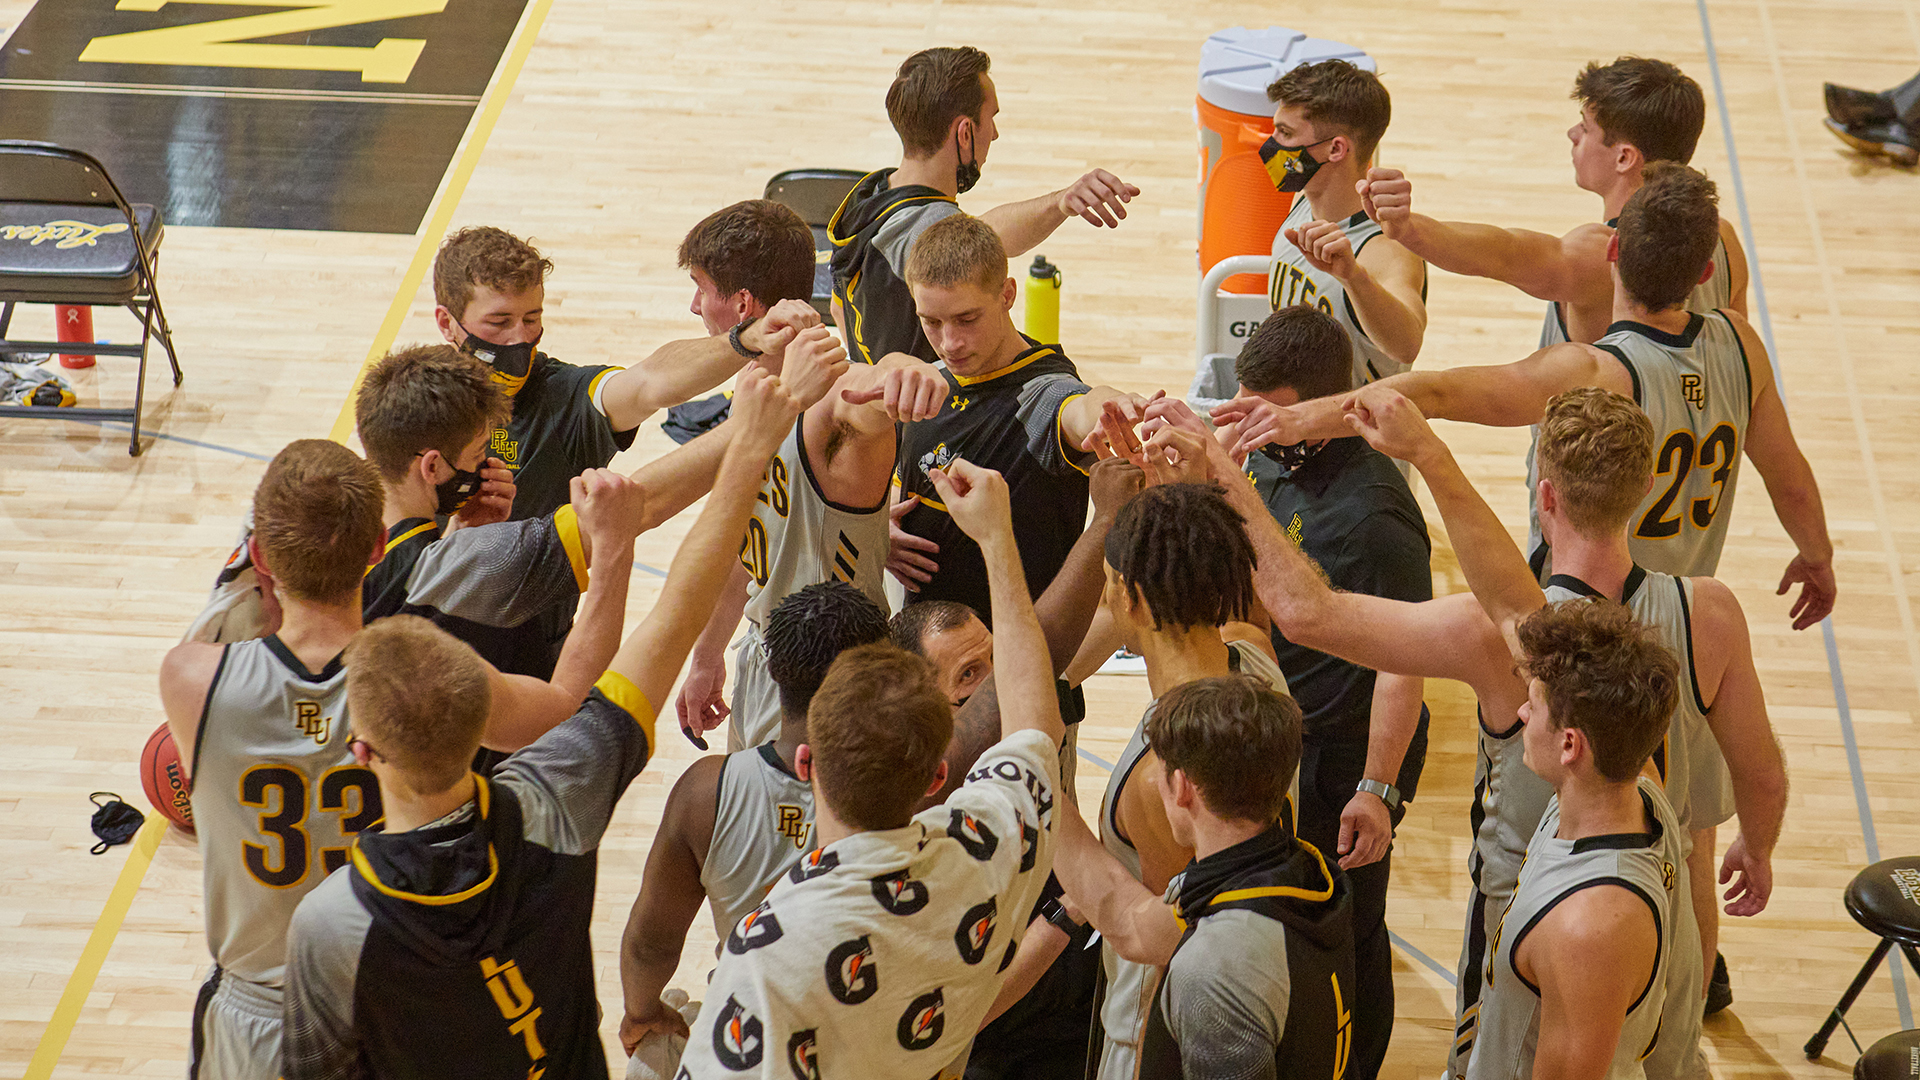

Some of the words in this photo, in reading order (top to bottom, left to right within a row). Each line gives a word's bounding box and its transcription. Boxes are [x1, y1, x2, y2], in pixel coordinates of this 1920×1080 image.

[0, 220, 129, 249] Lutes
[1269, 260, 1335, 318] UTE
[490, 428, 519, 462] PLU
[1632, 421, 1738, 540] 23
[294, 700, 332, 745] PLU
[238, 763, 386, 889] 33
[777, 804, 811, 849] PLU
[825, 934, 878, 1005] G
[480, 956, 547, 1080] LUT
